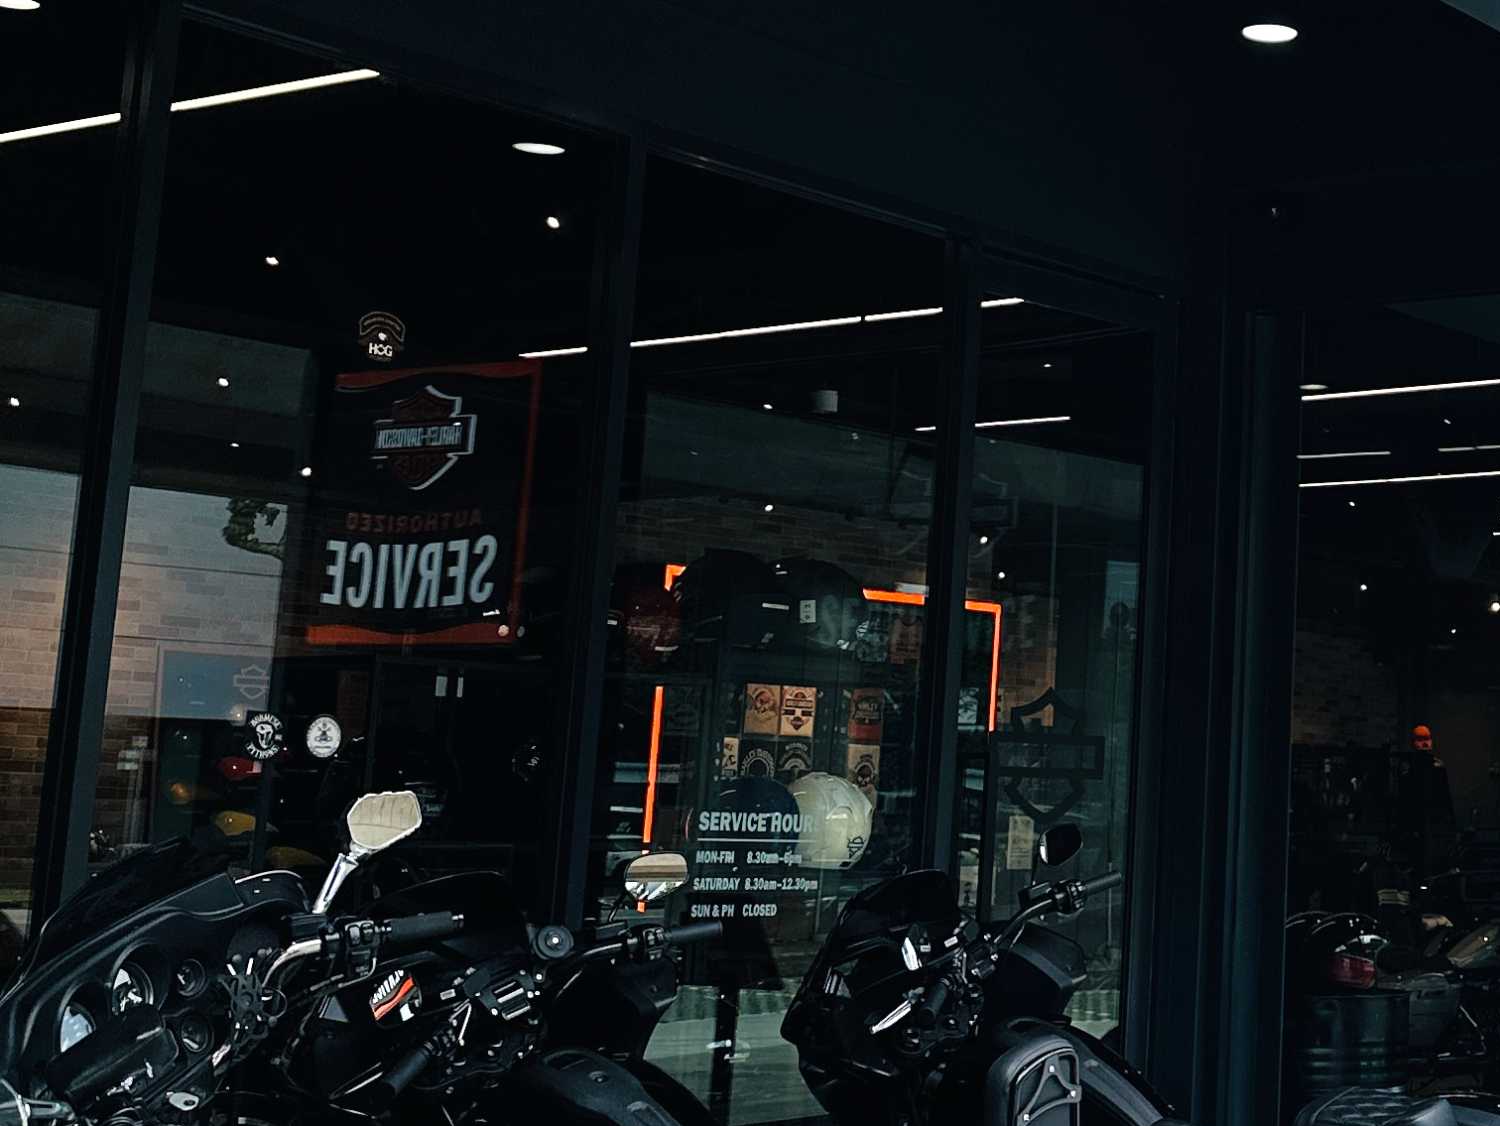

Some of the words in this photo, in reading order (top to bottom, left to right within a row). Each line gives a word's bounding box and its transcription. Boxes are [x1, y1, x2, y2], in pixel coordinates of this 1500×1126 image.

[698, 811, 767, 832] SERVICE
[771, 812, 815, 834] HOUR
[695, 850, 735, 864] MON-FRI
[693, 878, 740, 891] SATURDAY
[691, 904, 710, 918] SUN
[711, 904, 720, 918] &
[721, 904, 735, 918] PH
[742, 904, 778, 918] CLOSED
